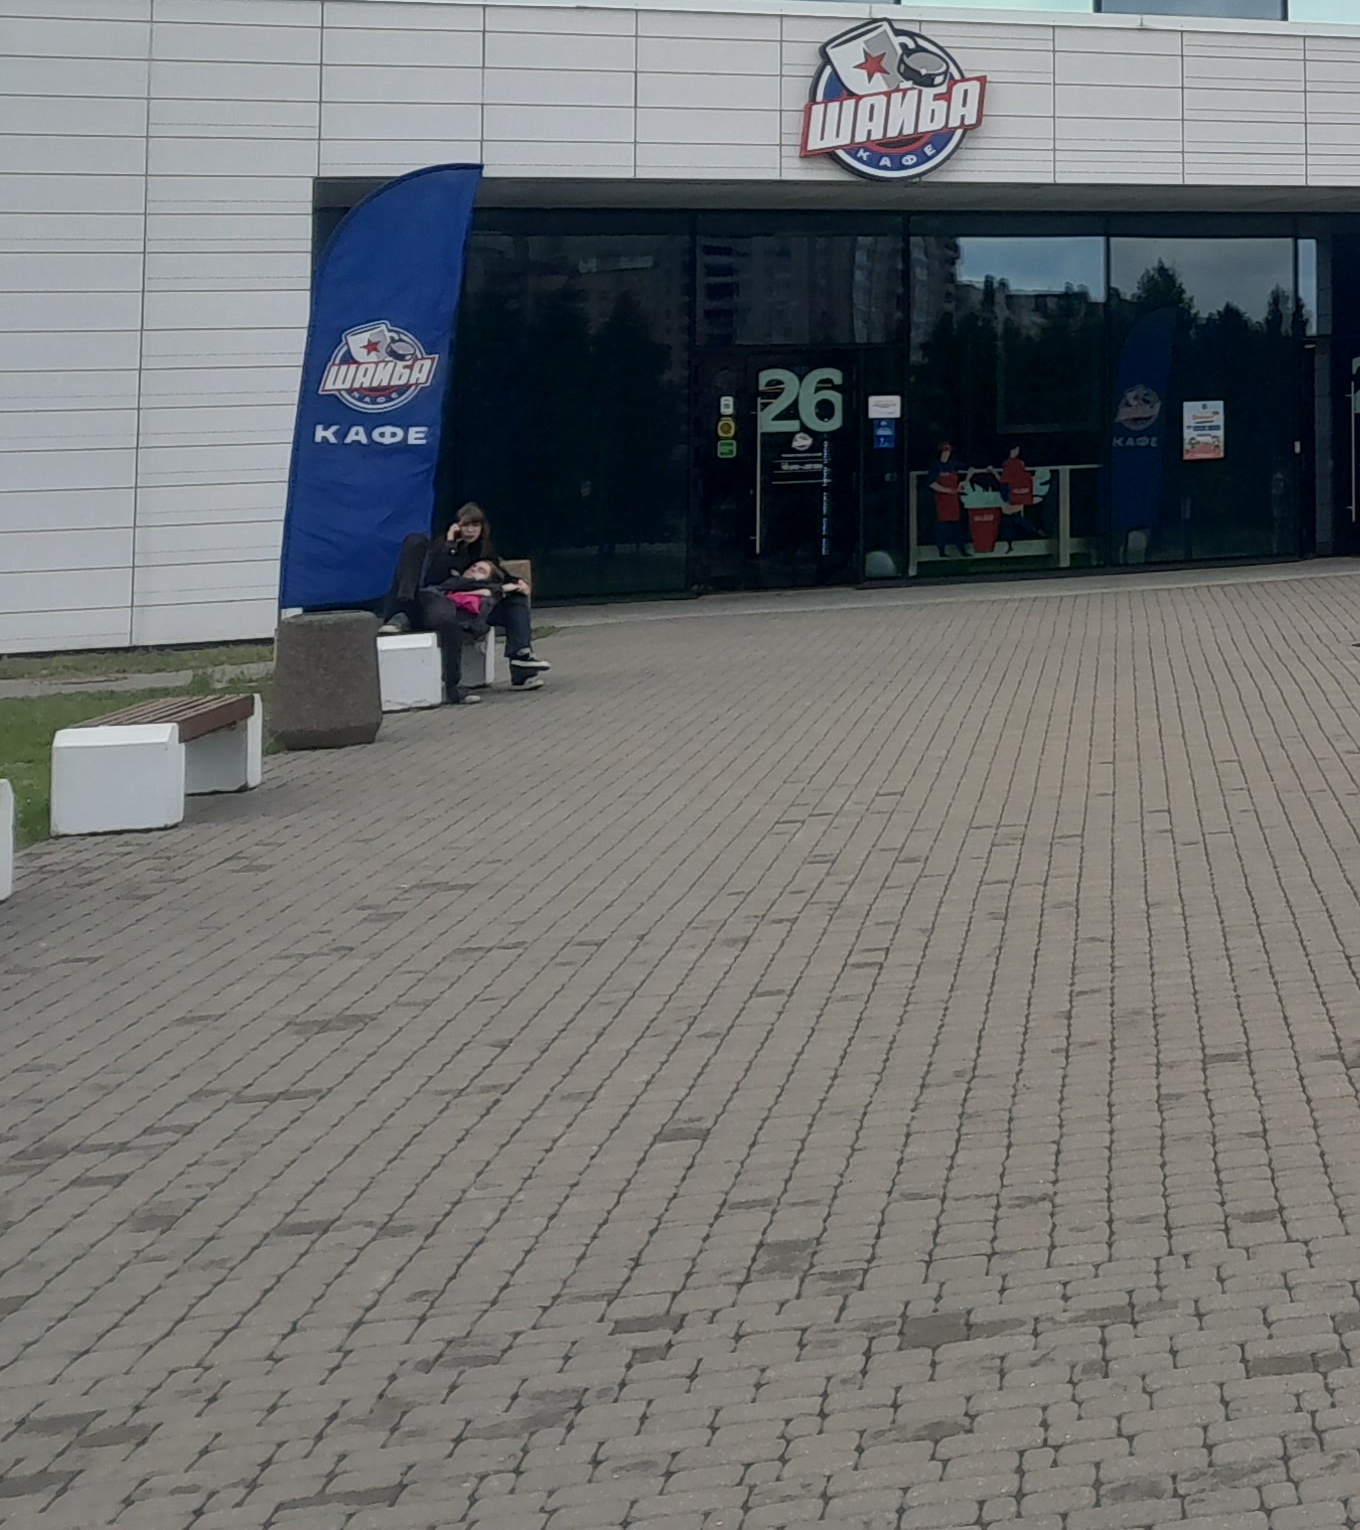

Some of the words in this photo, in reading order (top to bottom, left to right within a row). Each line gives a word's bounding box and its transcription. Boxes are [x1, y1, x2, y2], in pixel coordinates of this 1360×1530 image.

[806, 79, 982, 152] ШАЙБА
[856, 144, 936, 168] КАФЕ
[324, 358, 433, 391] ШАЙБА
[758, 367, 844, 433] 26
[314, 423, 429, 445] КАФЕ
